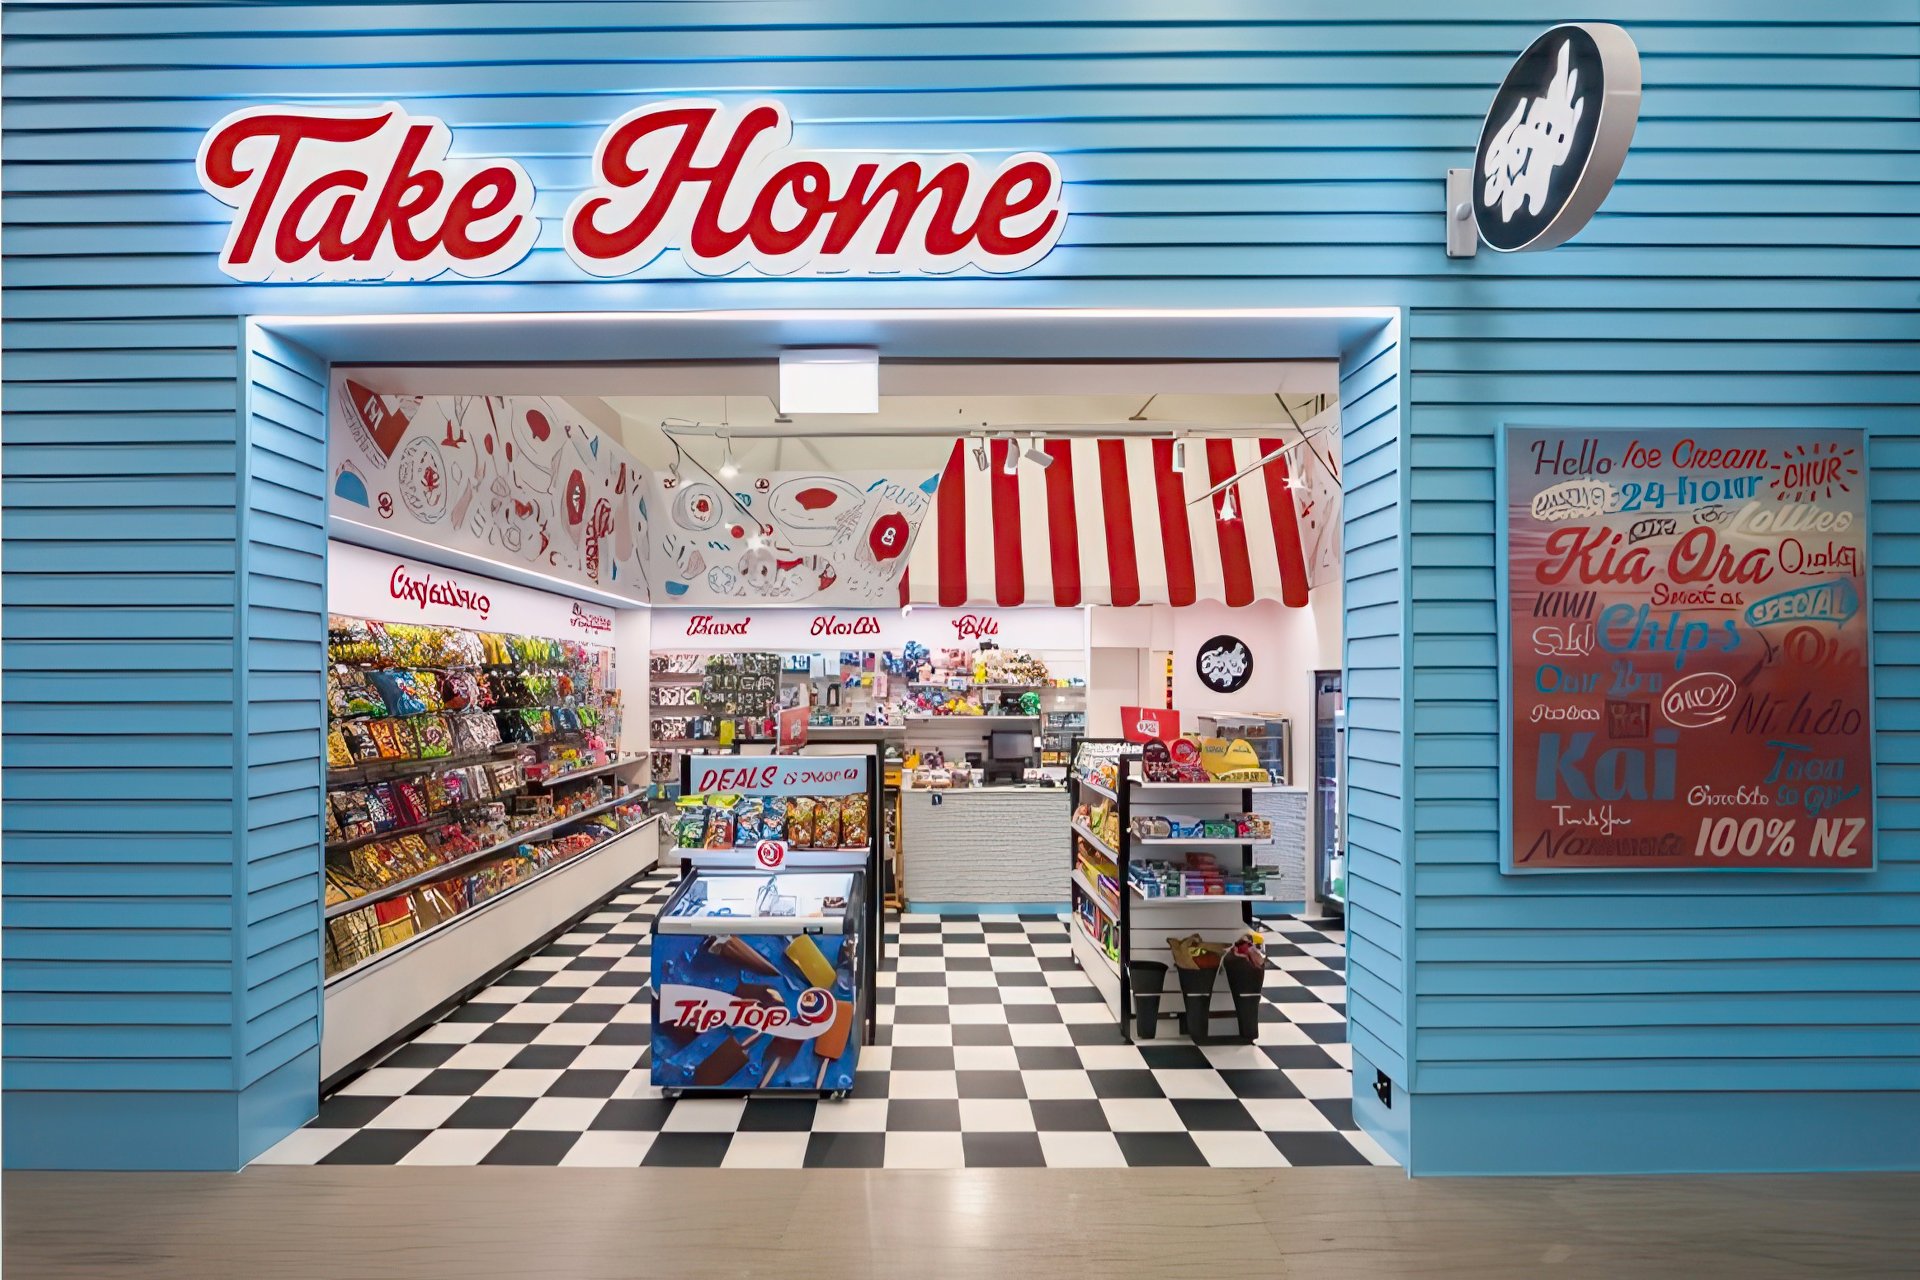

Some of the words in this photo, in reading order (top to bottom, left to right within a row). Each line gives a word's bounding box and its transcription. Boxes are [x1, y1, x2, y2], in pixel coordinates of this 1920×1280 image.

[206, 111, 522, 264] Take
[572, 106, 1059, 258] Home
[1531, 439, 1612, 475] Hello
[1672, 439, 1768, 469] Cream
[1536, 526, 1656, 585] Kia
[1667, 526, 1774, 585] Ora
[699, 766, 778, 792] DEALS
[1535, 730, 1680, 801] Kai
[1694, 817, 1797, 857] 100%
[1809, 817, 1866, 857] NZ
[674, 1000, 727, 1031] Tip
[729, 1000, 788, 1031] Top
